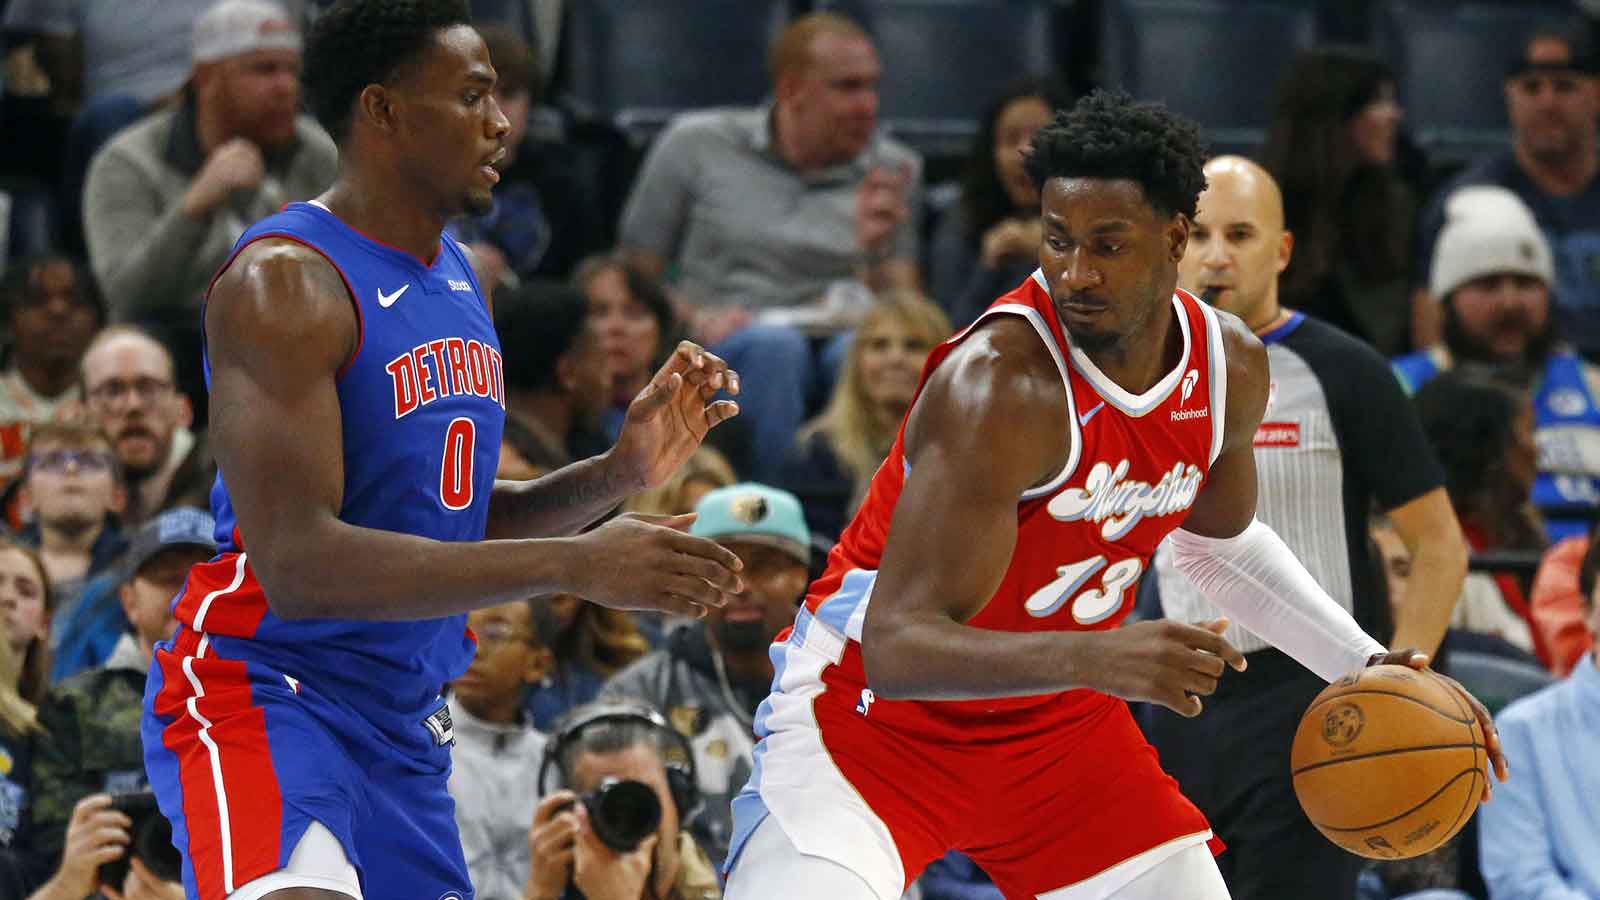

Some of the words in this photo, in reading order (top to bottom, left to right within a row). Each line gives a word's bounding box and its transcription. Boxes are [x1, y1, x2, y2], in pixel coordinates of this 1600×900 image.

[1170, 406, 1208, 421] Robinhood
[439, 416, 476, 511] 0
[1046, 458, 1204, 543] Memphis
[1024, 554, 1143, 626] 13
